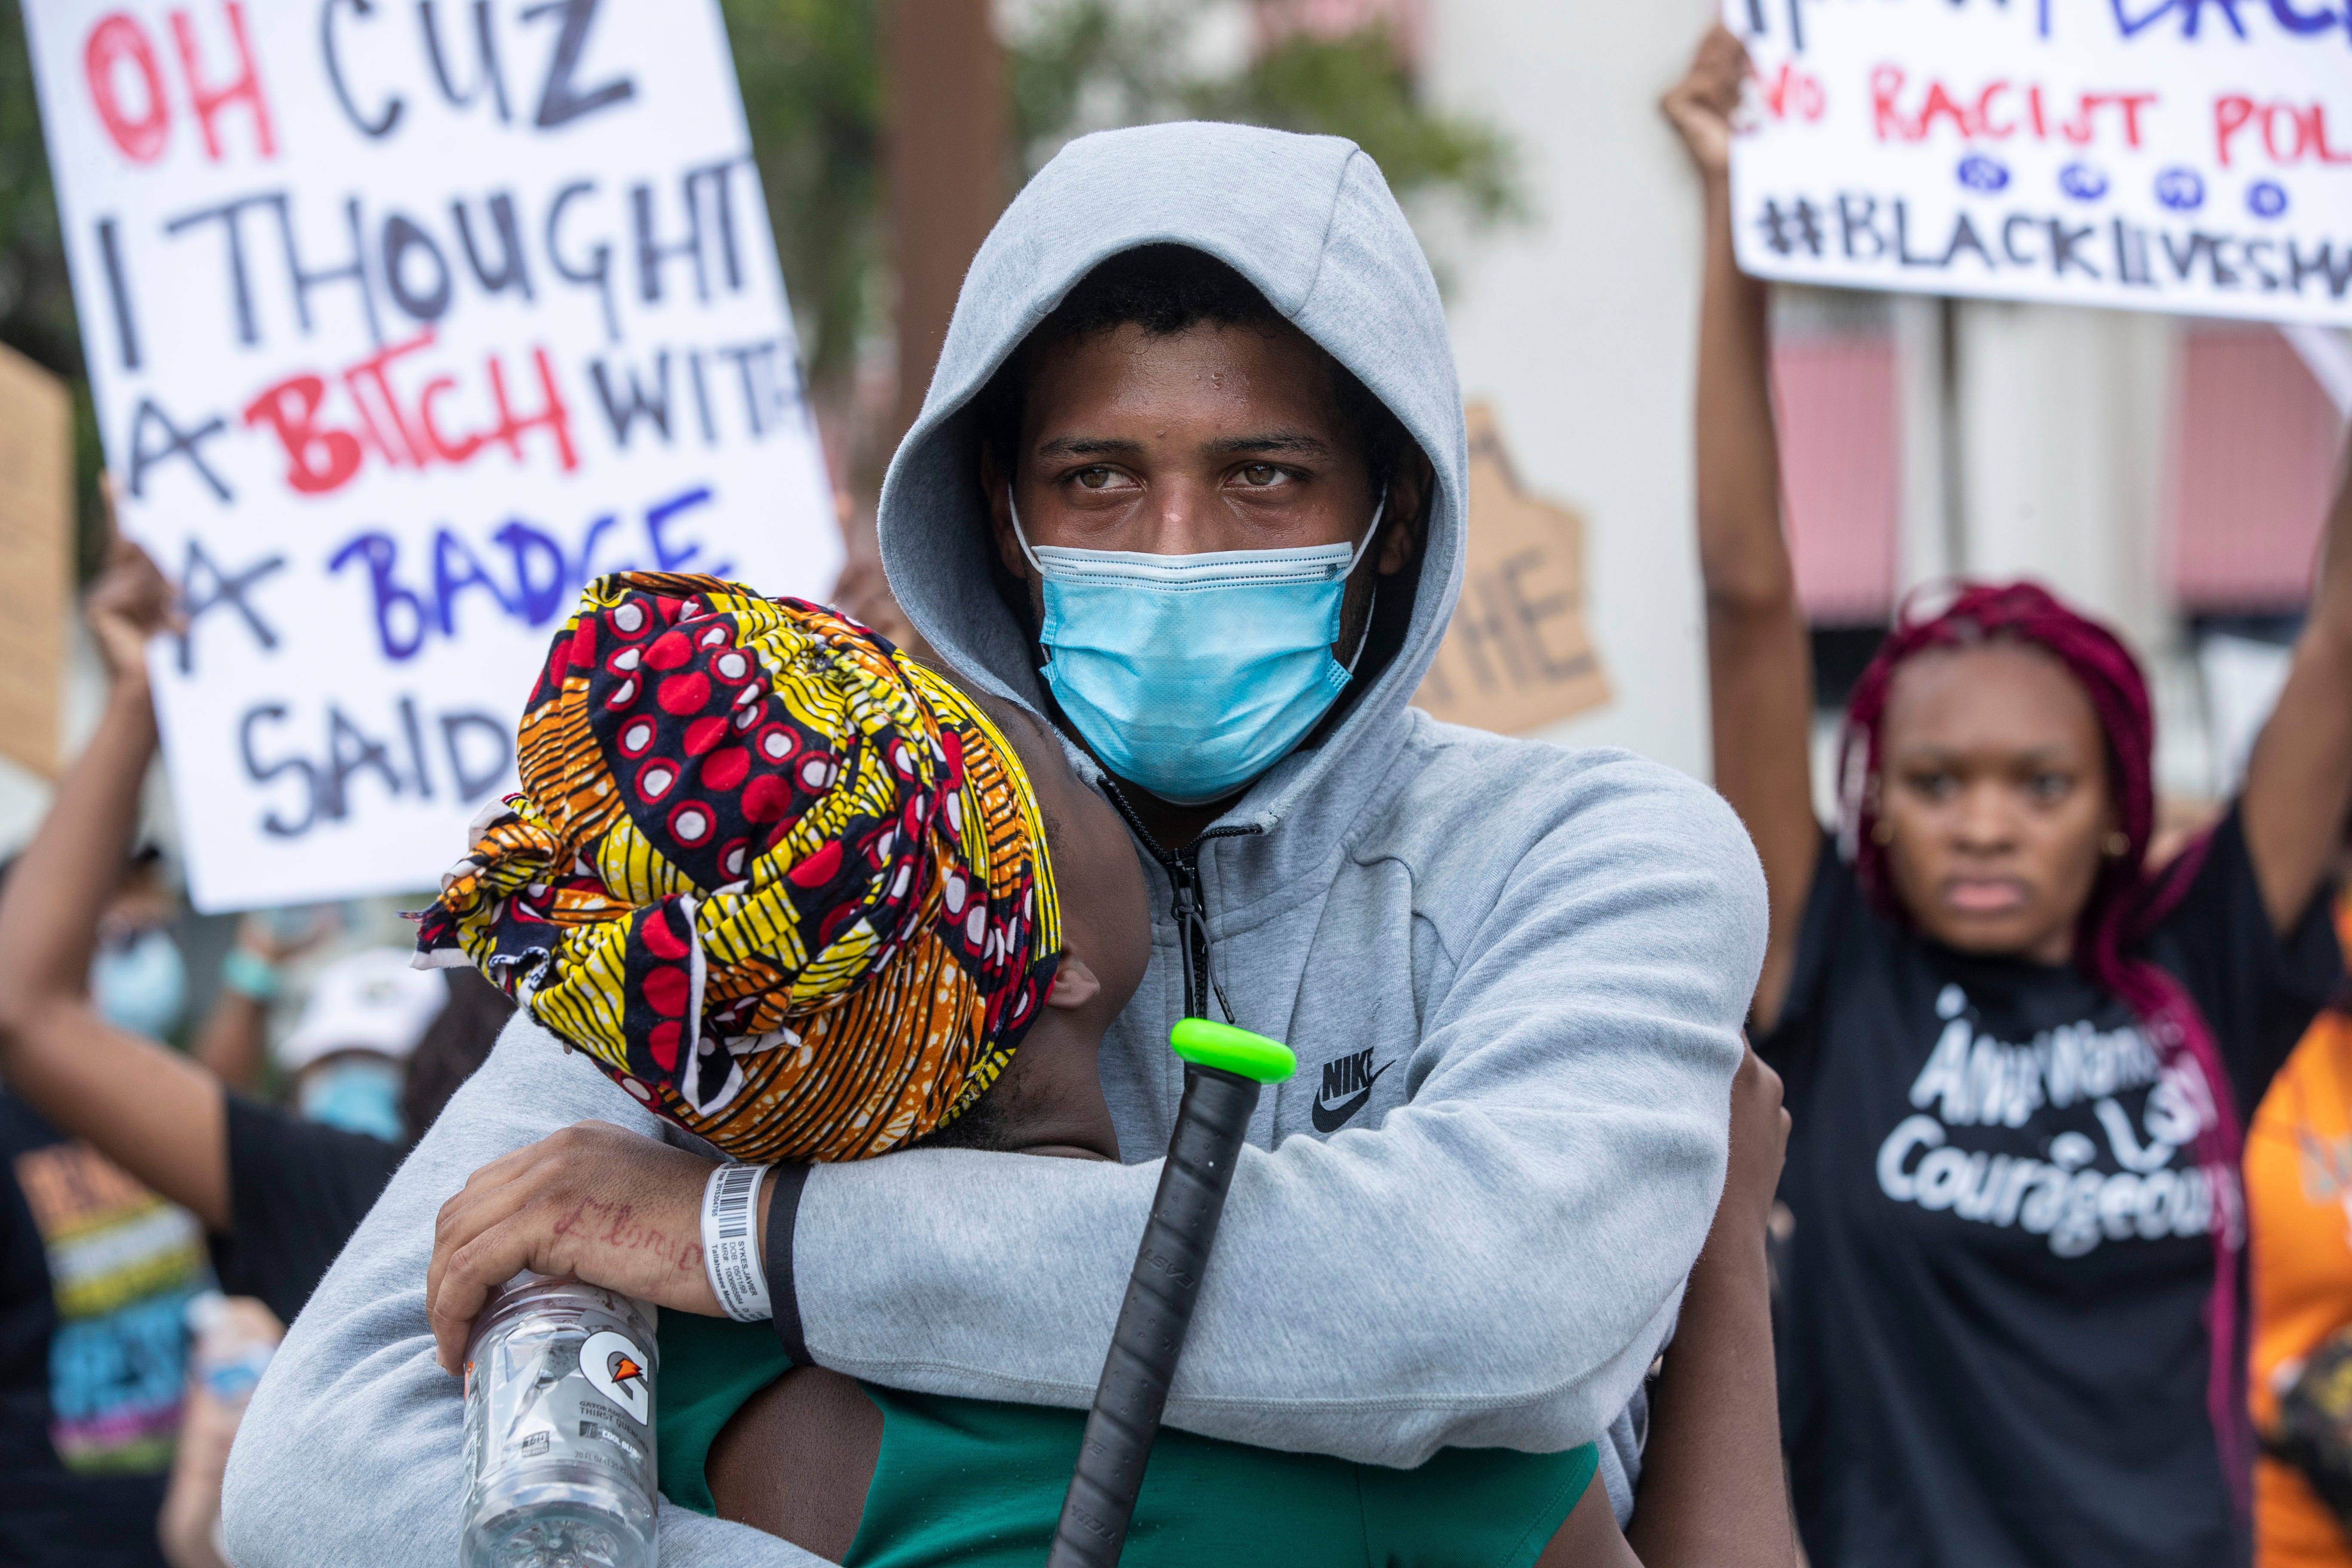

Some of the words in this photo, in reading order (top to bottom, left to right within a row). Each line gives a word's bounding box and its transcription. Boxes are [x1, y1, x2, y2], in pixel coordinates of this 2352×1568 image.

[82, 2, 279, 164] OH
[320, 0, 636, 140] CUZ
[1868, 64, 2157, 147] RACIST
[2214, 95, 2352, 165] POL
[97, 217, 144, 372] I
[161, 153, 757, 349] THOUGHT
[127, 396, 234, 503] A
[242, 325, 579, 496] BITCH
[175, 539, 286, 676] A
[239, 697, 519, 839] SAID
[712, 1243, 726, 1289] Tallahassee
[729, 1242, 738, 1263] DOB:
[579, 1406, 613, 1422] THIRST
